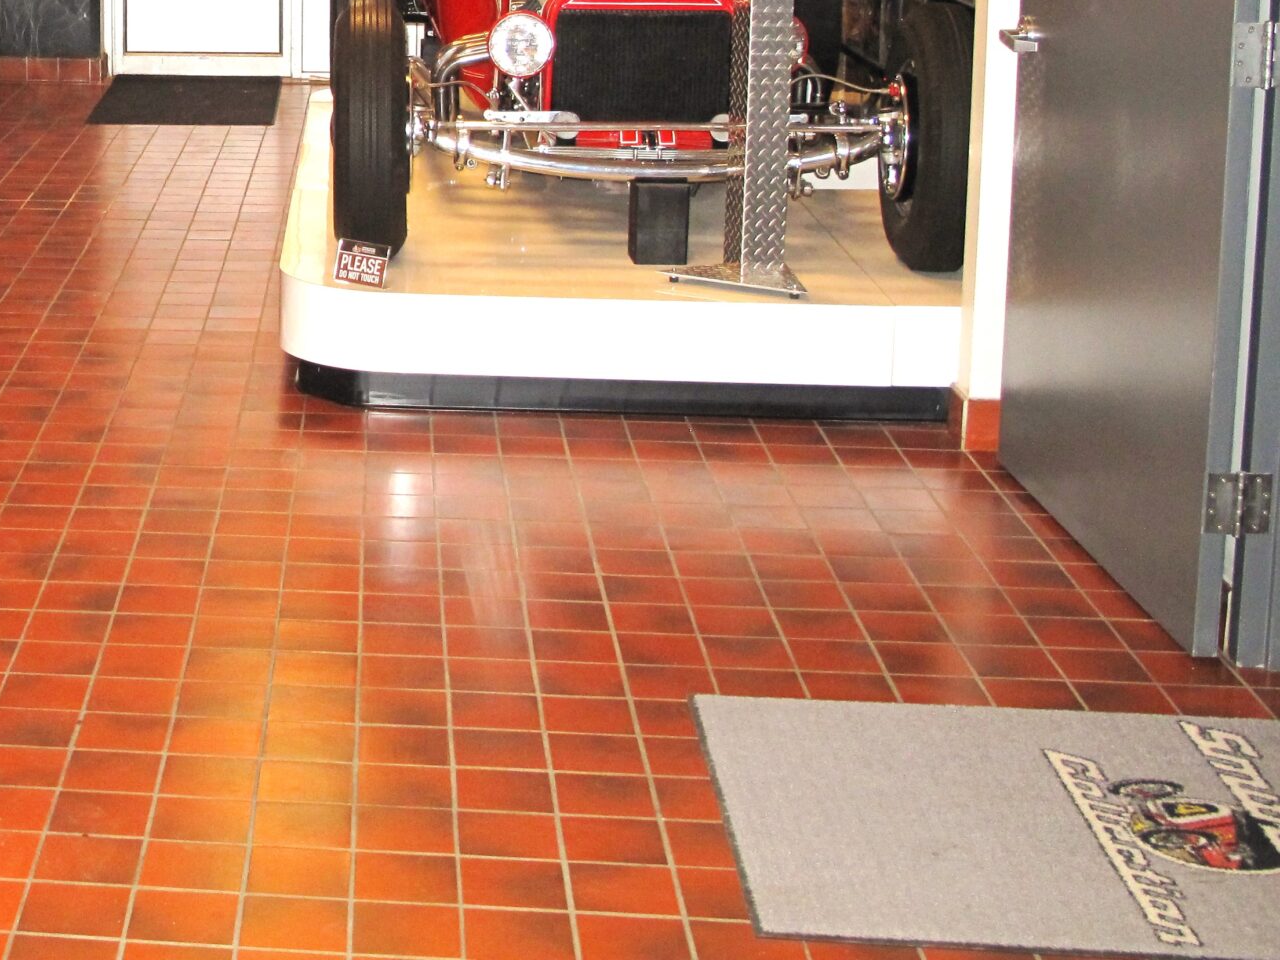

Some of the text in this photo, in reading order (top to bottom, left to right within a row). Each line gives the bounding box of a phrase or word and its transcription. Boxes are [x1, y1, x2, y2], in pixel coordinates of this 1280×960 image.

[340, 253, 383, 275] PLEASE
[338, 269, 380, 284] DO NOT TOUCH
